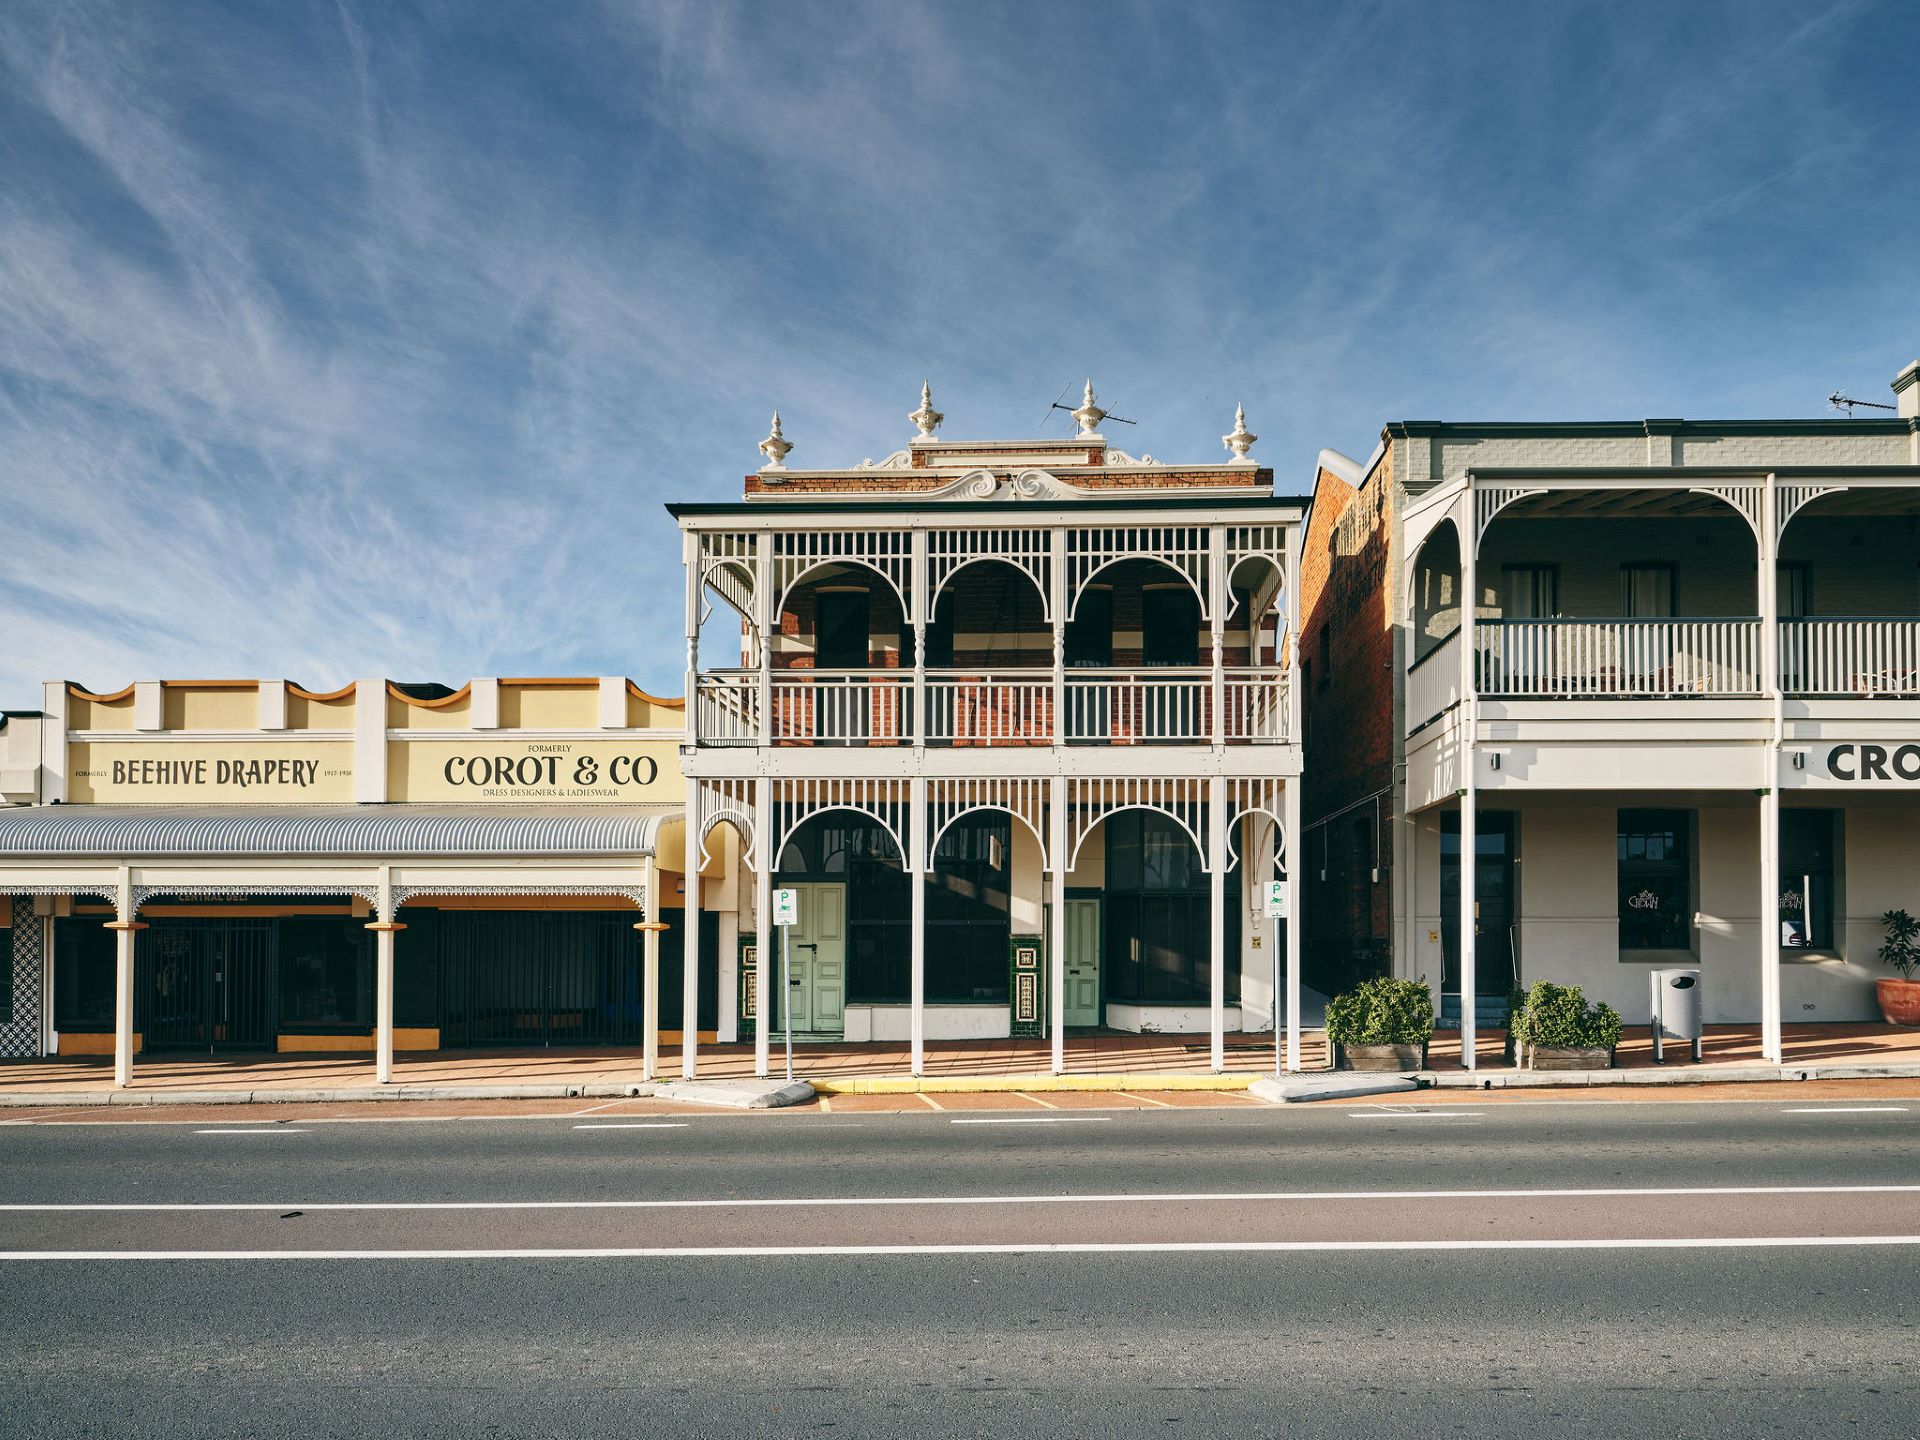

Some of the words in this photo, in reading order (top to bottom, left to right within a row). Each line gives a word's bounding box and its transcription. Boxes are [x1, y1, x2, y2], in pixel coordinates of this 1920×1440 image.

[527, 744, 572, 753] FORMERLY
[1826, 744, 1920, 780] CRO
[112, 759, 207, 785] BEEHIVE
[216, 759, 320, 788] DRAPERY
[444, 756, 563, 786] COROT
[573, 755, 599, 786] &
[609, 755, 659, 786] CO
[482, 788, 508, 797] DRESS
[510, 788, 557, 797] DESIGNERS
[558, 788, 566, 797] &
[567, 788, 620, 797] LADIESWEAR
[1272, 884, 1281, 894] P
[178, 892, 224, 901] CENTRAL
[226, 892, 249, 901] DELI
[780, 892, 789, 902] P
[1778, 895, 1803, 909] ROWN
